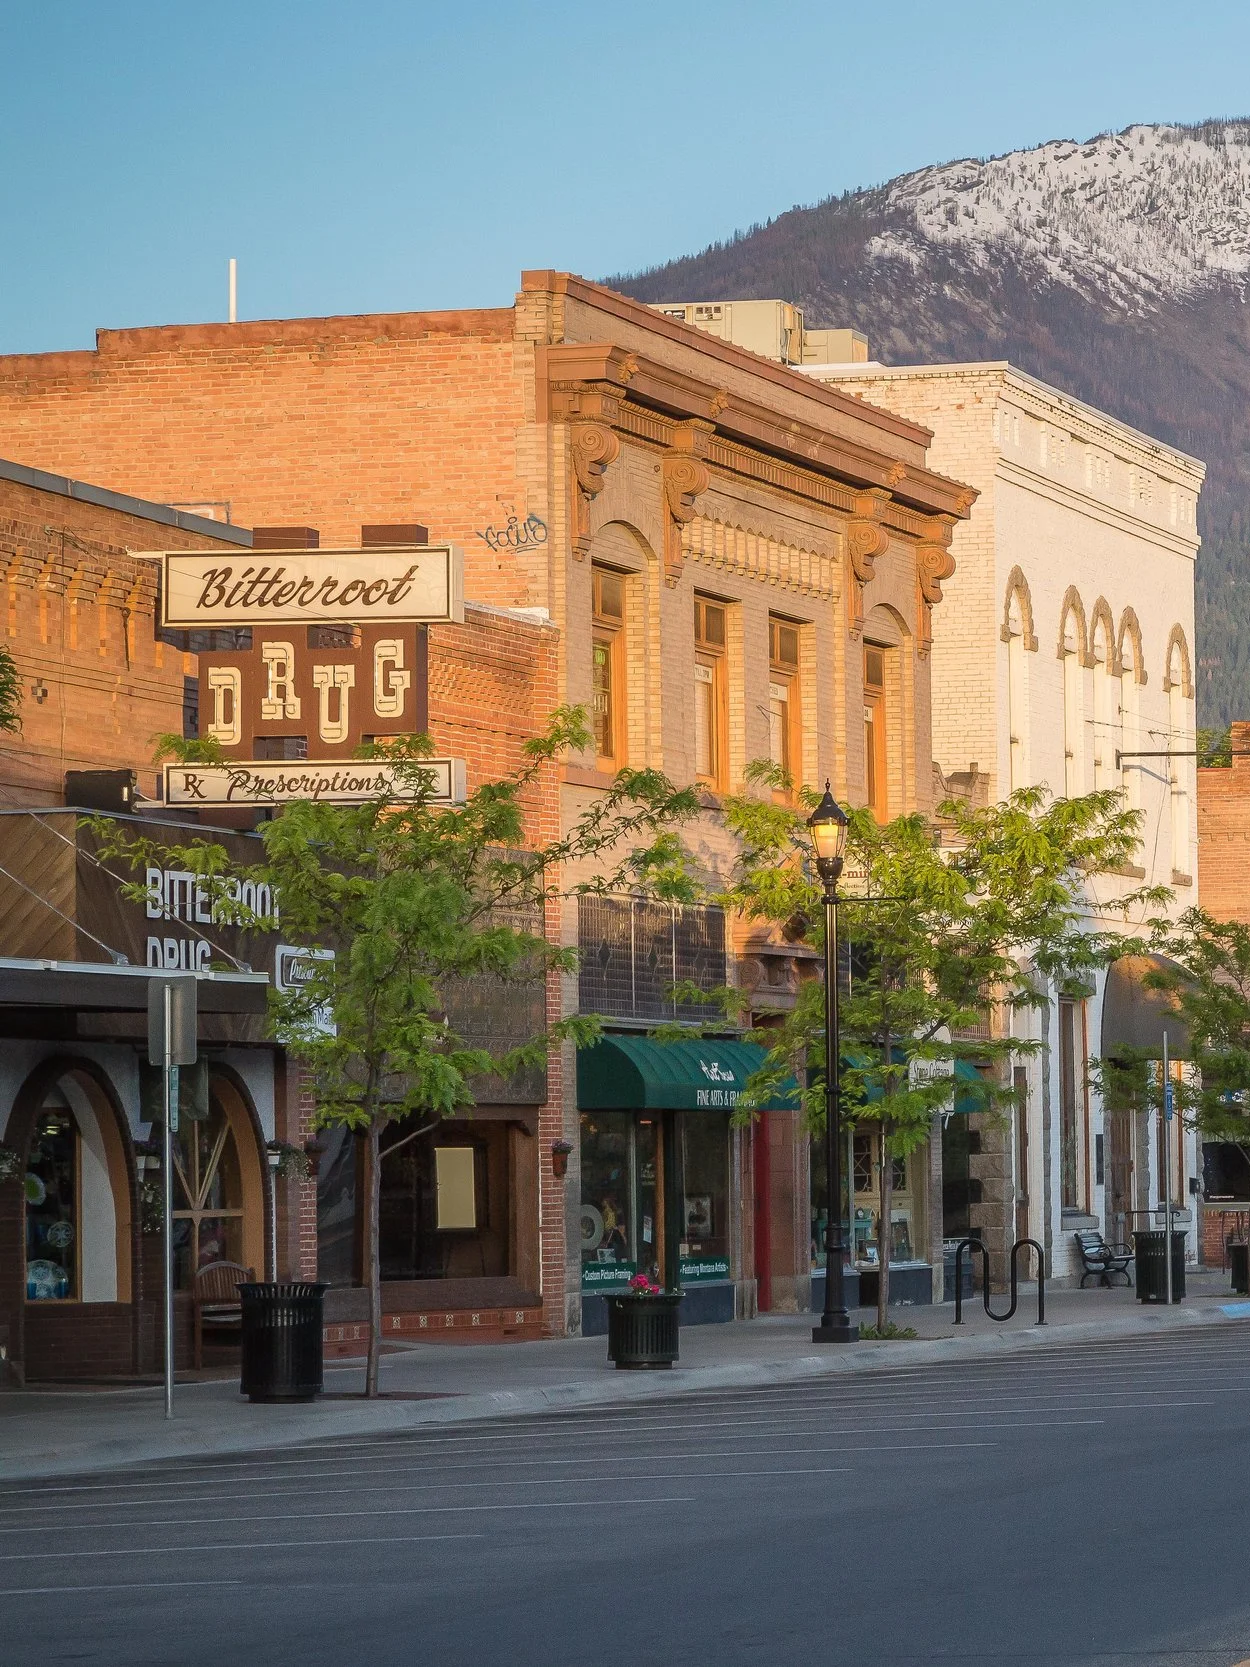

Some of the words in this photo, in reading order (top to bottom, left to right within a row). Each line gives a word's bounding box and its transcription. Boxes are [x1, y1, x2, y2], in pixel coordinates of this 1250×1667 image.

[196, 564, 419, 609] Bitterroot
[208, 638, 411, 746] DRUG
[226, 769, 387, 800] Prescriptions
[697, 1090, 709, 1105] FINE
[710, 1090, 723, 1106] ARTS
[724, 1091, 729, 1106] &
